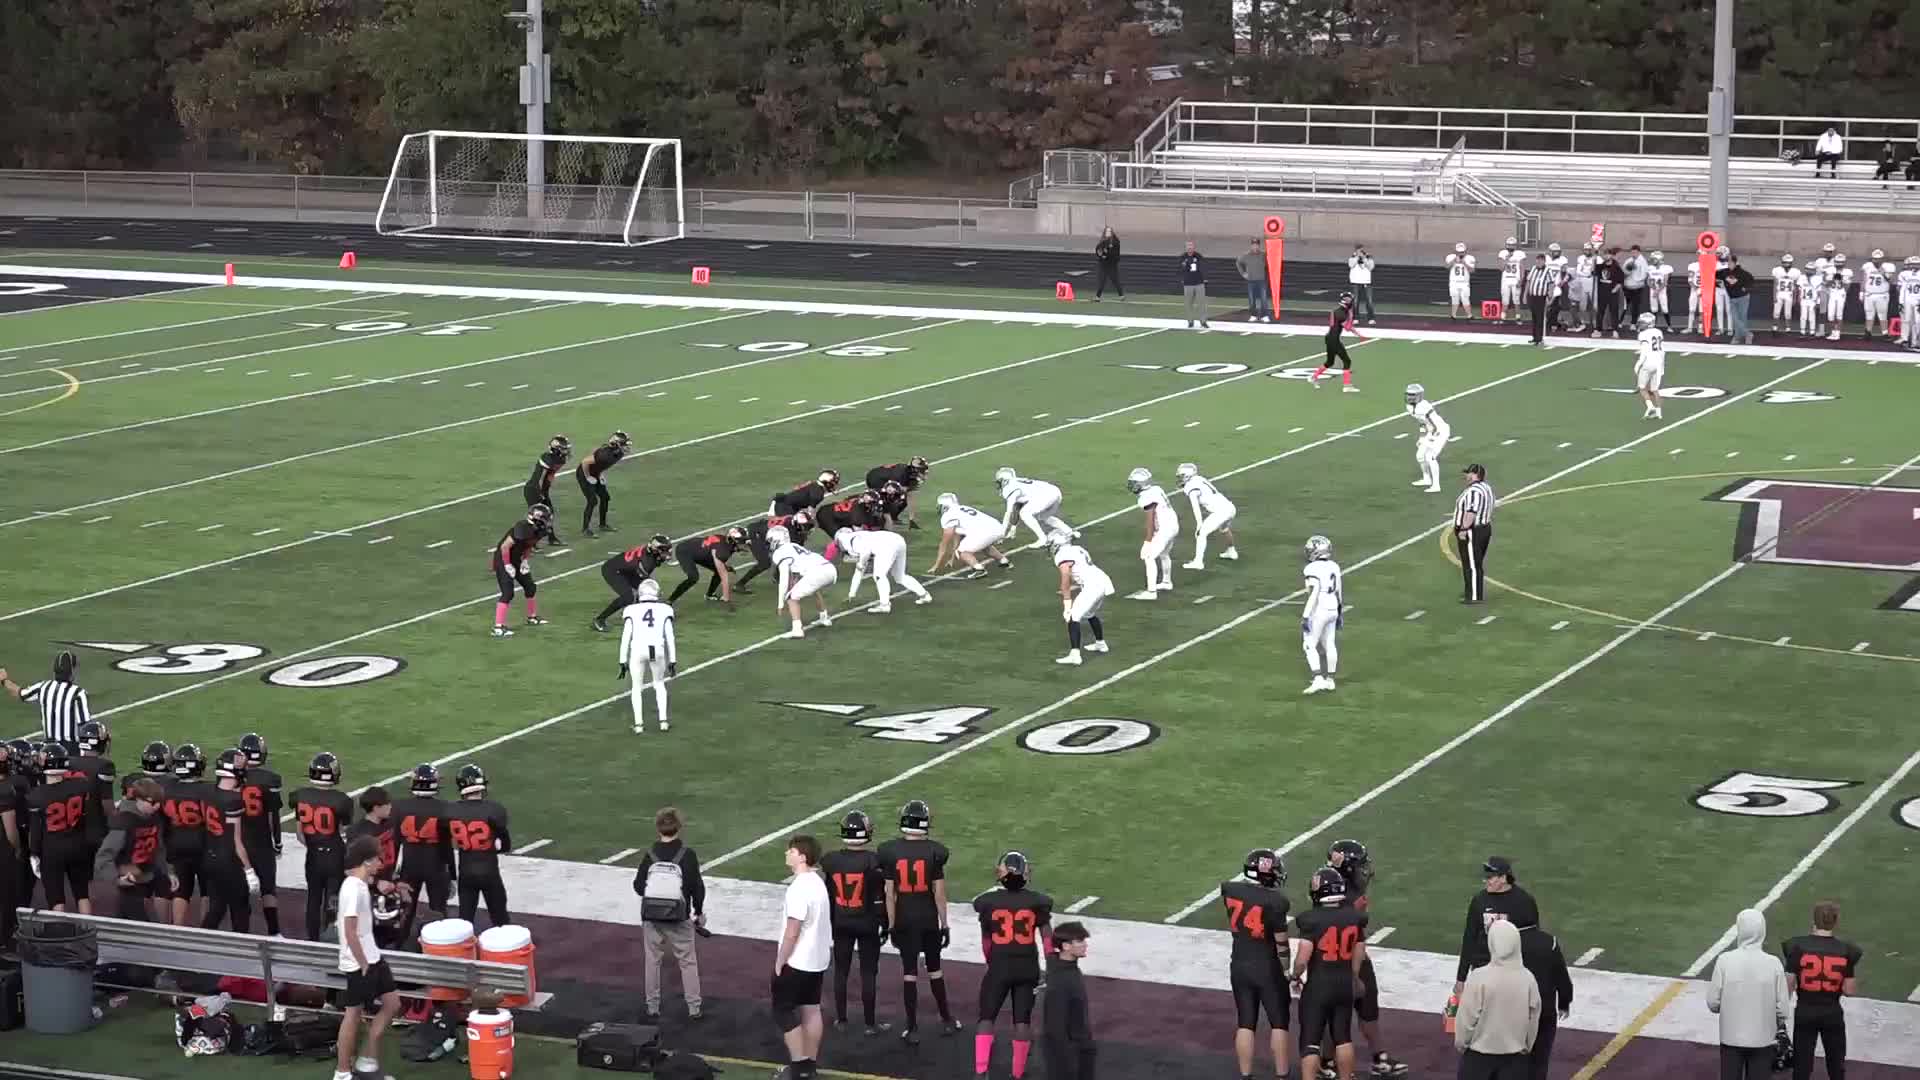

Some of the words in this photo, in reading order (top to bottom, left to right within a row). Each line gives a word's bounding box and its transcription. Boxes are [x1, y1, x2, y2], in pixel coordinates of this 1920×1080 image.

[696, 269, 706, 282] 10
[1484, 303, 1498, 317] 30
[642, 608, 655, 627] 4
[297, 802, 335, 836] 20
[400, 815, 440, 844] 44
[832, 872, 865, 908] 17
[895, 858, 929, 893] 11
[991, 909, 1036, 945] 33
[1225, 897, 1265, 938] 74
[1317, 925, 1359, 961] 40
[1799, 953, 1848, 992] 25
